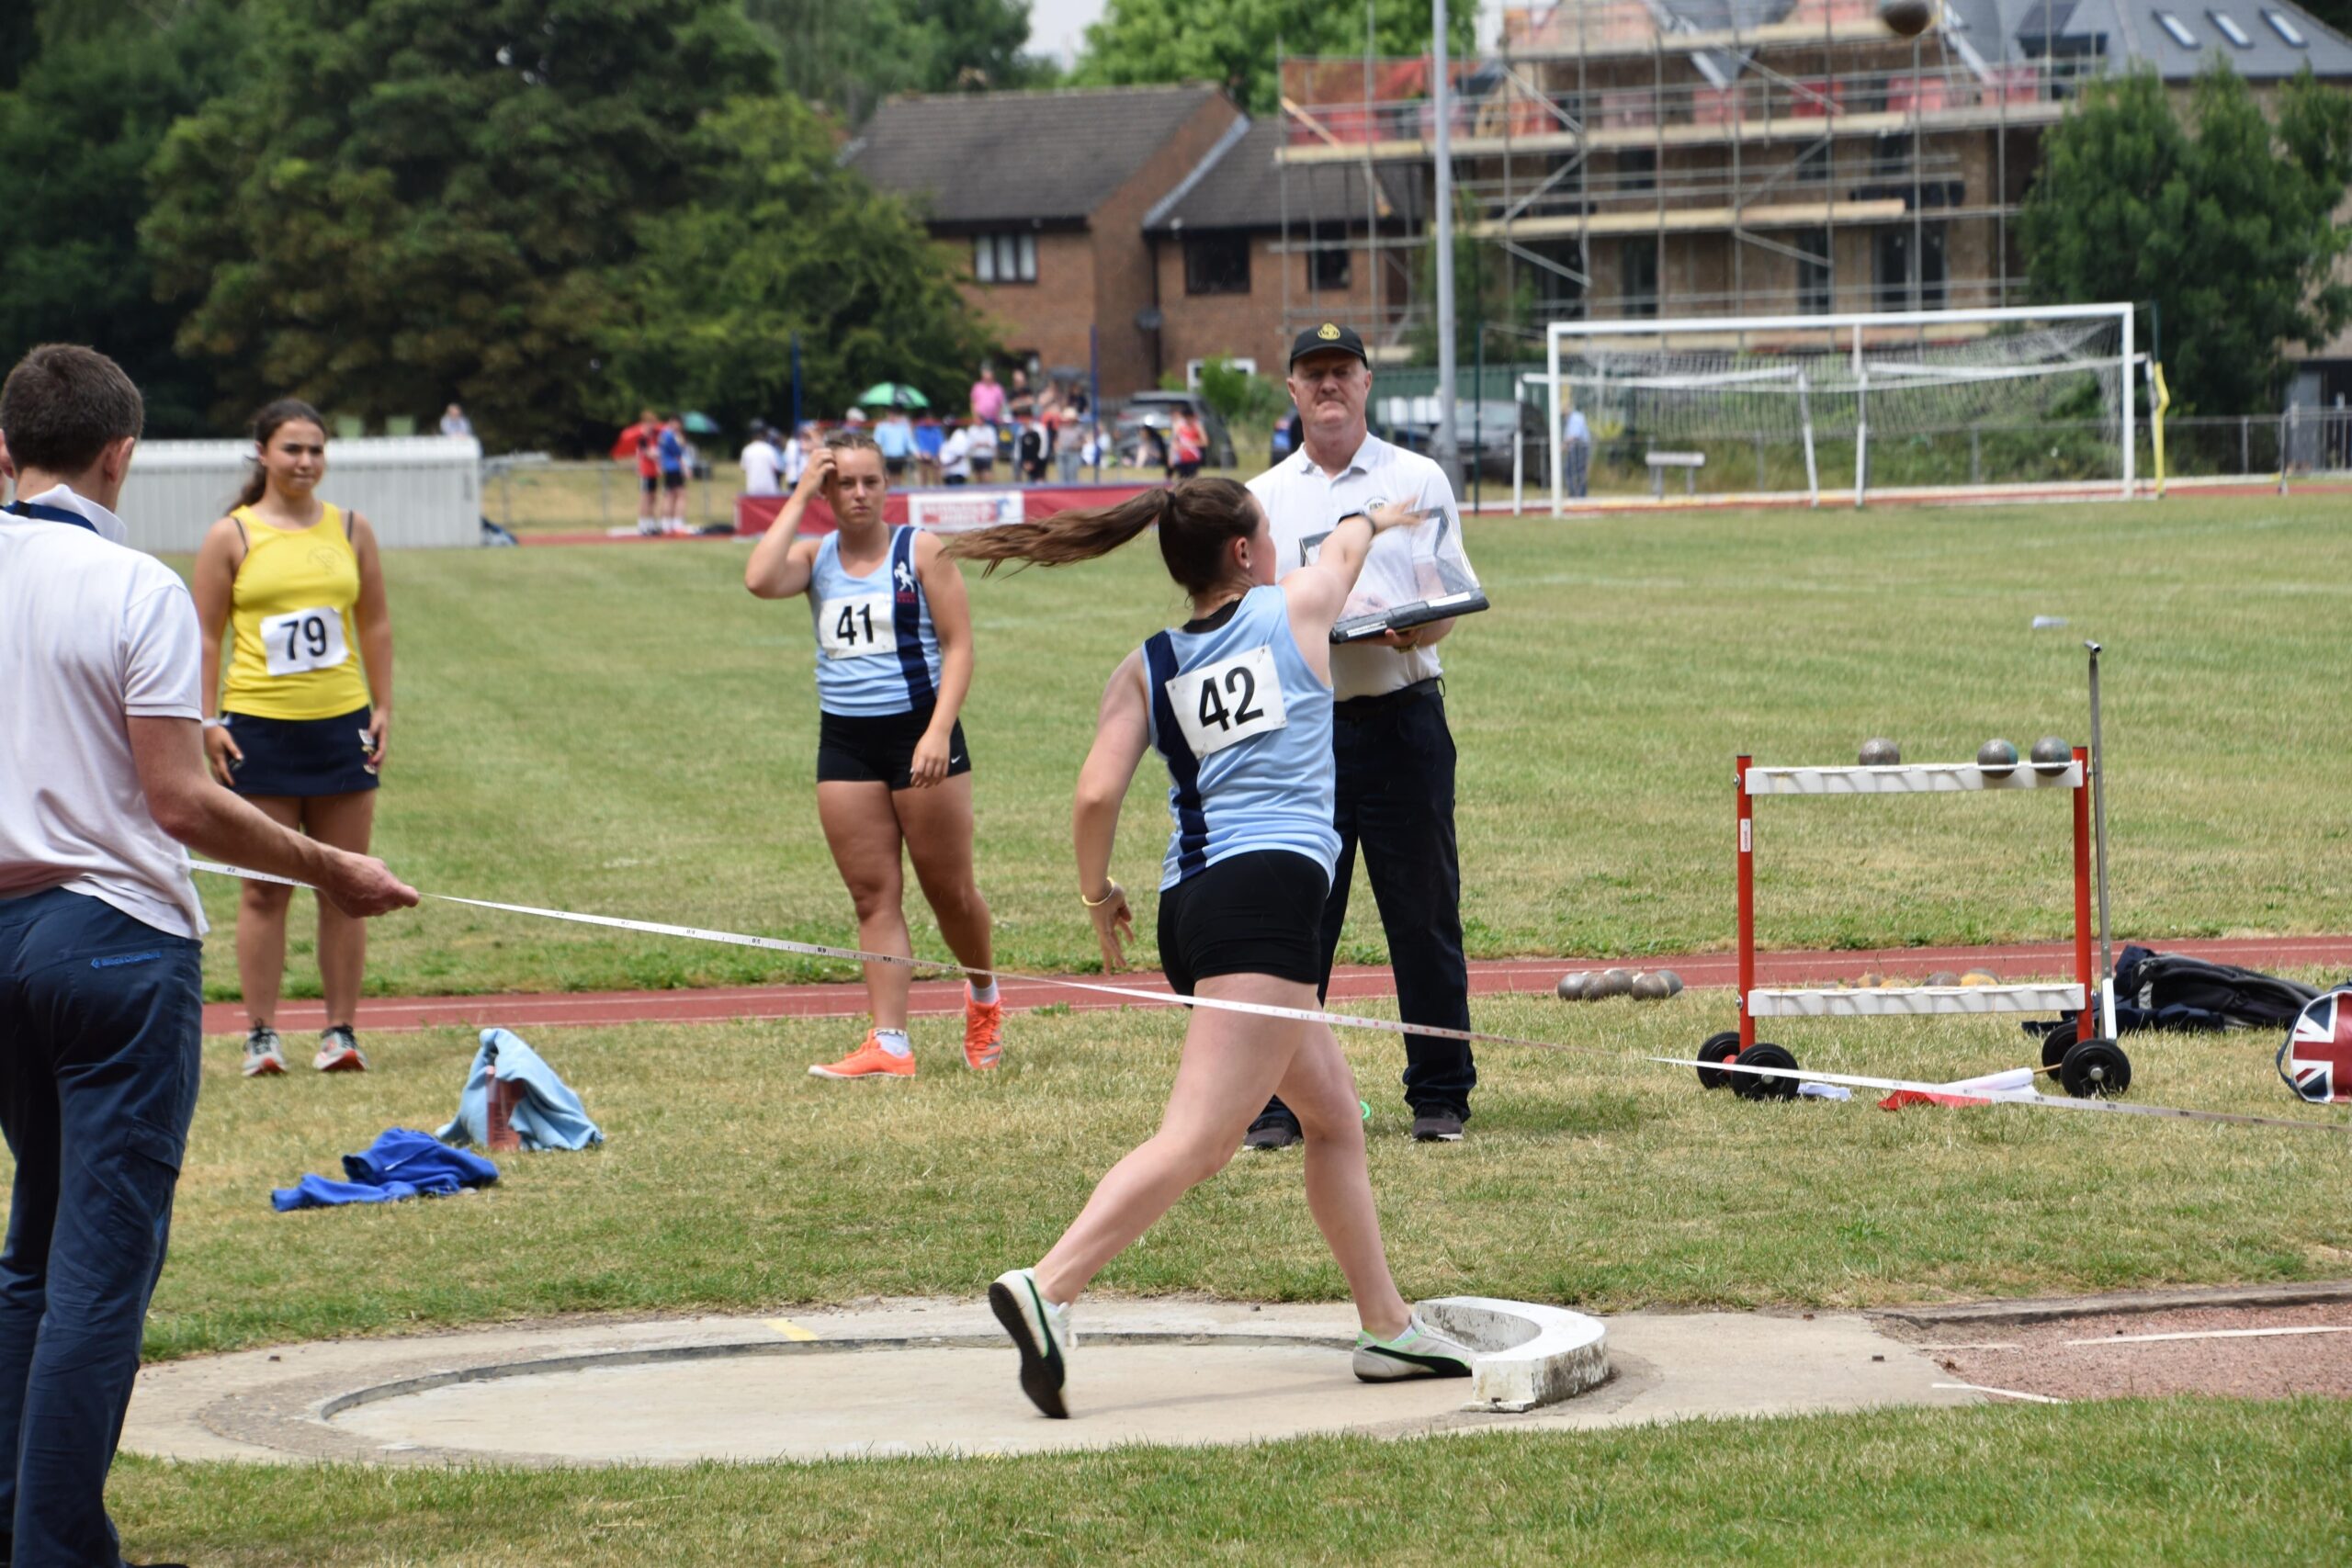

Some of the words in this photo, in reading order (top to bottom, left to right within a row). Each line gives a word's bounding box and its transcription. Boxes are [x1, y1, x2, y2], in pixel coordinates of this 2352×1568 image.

[280, 615, 327, 660] 79
[837, 604, 874, 646] 41
[1199, 666, 1264, 732] 42
